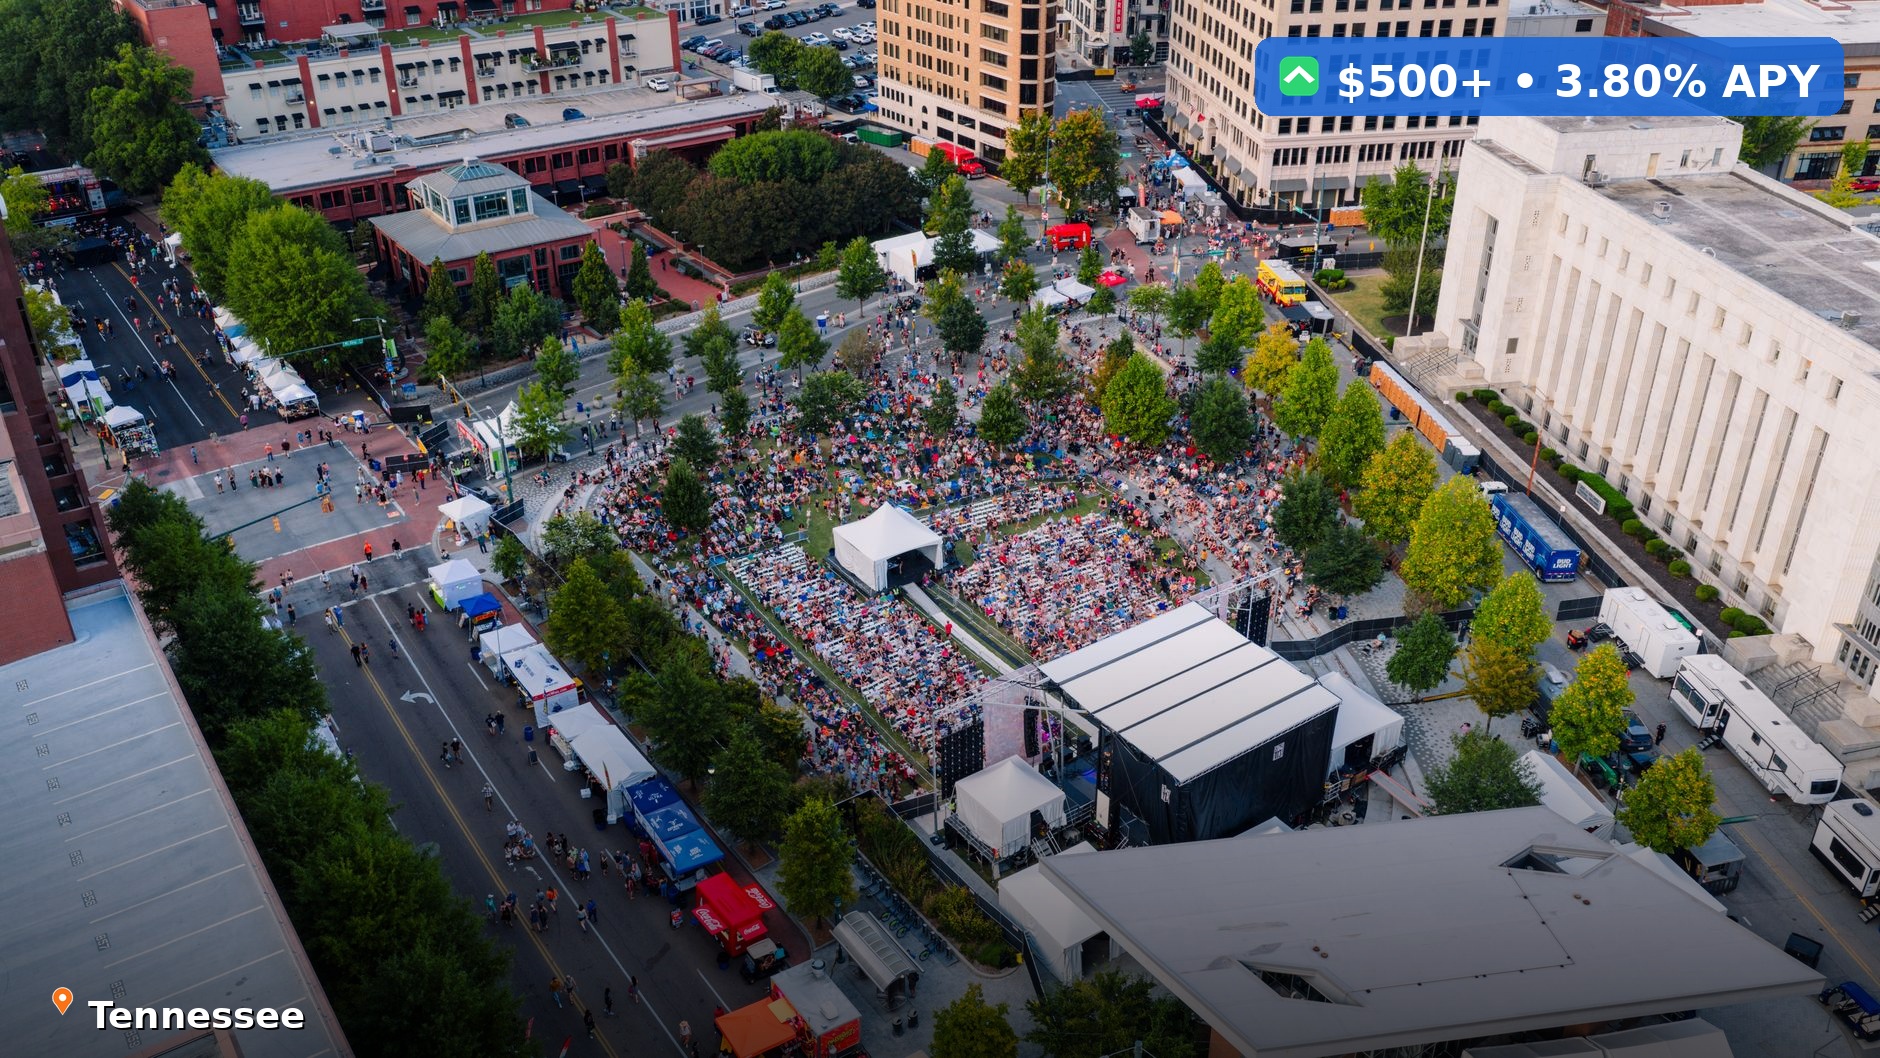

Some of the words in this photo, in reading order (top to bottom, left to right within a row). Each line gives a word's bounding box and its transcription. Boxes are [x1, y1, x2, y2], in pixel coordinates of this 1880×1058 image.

[695, 908, 723, 931] Coca-Cola
[94, 934, 110, 950] 857
[110, 980, 126, 999] 858
